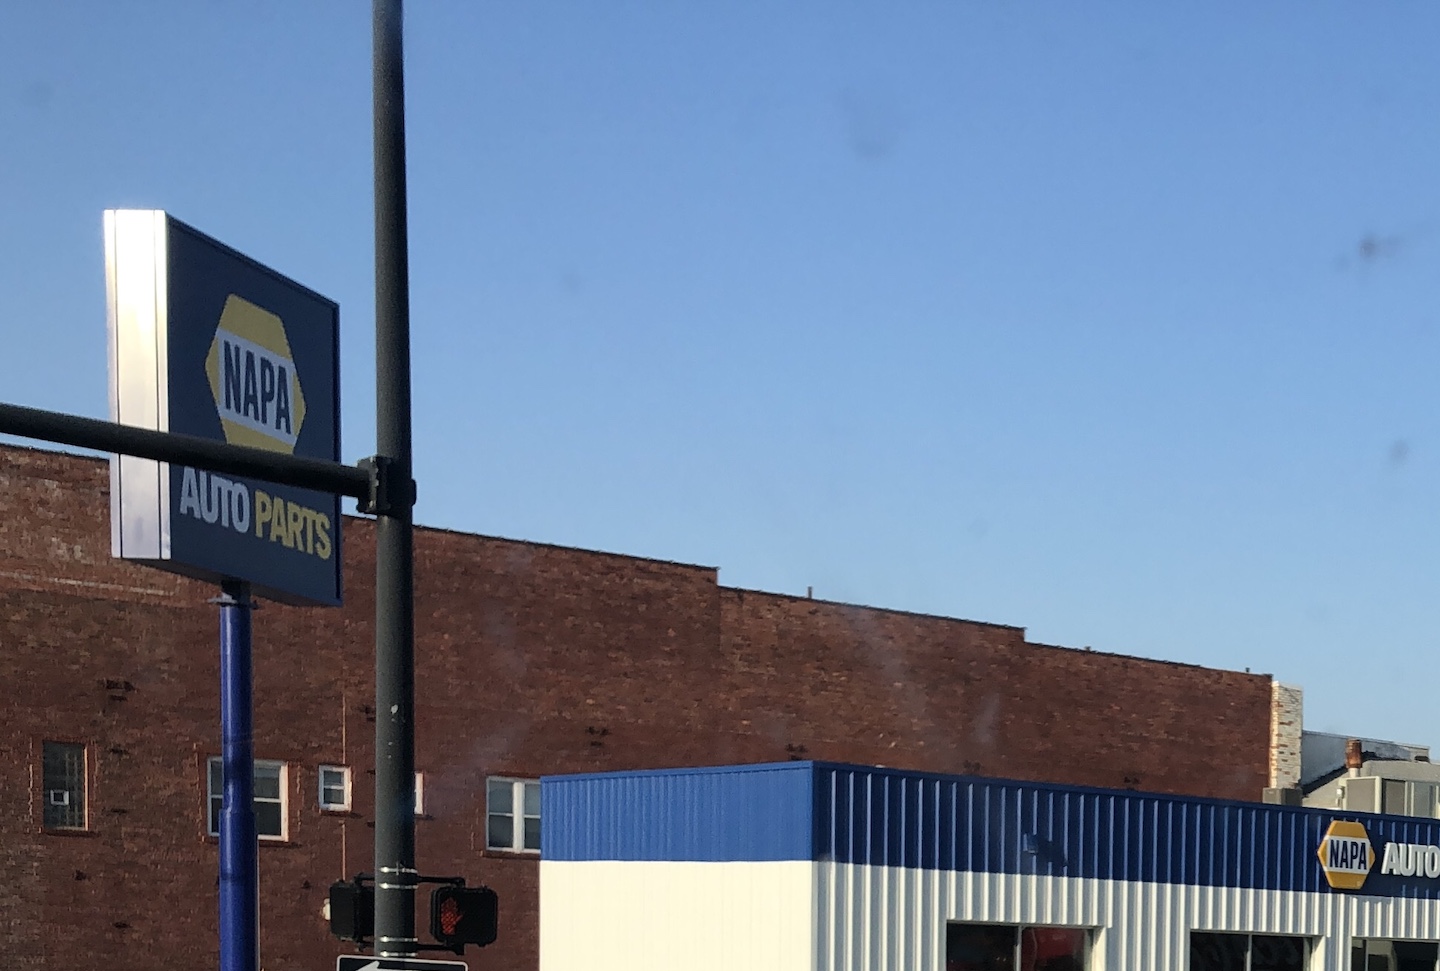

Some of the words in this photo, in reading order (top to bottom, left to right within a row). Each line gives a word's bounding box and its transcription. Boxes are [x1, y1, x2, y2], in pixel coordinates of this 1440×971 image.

[223, 340, 292, 436] NAPA
[180, 468, 250, 534] AUTO
[255, 489, 332, 561] PARTS
[1329, 839, 1368, 871] NAPA
